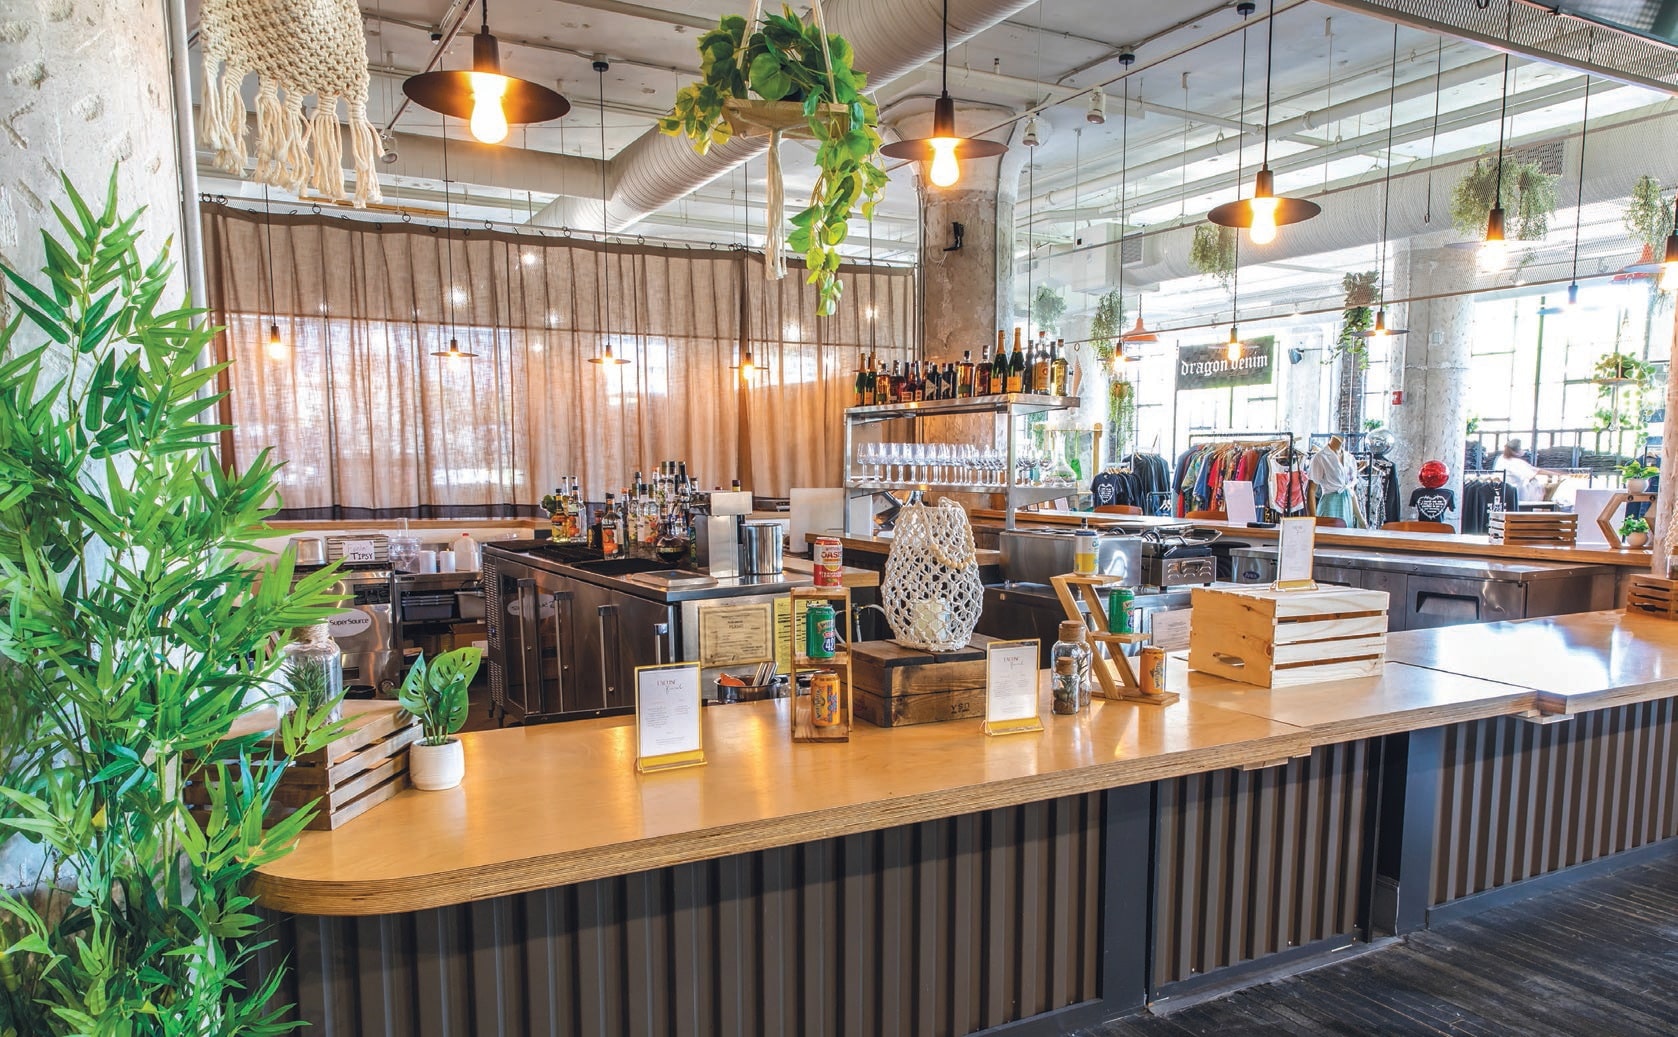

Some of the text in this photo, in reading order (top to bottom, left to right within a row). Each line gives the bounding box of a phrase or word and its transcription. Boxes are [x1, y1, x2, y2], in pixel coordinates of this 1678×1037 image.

[1181, 351, 1268, 377] dragon denim
[350, 552, 373, 560] TIPSY
